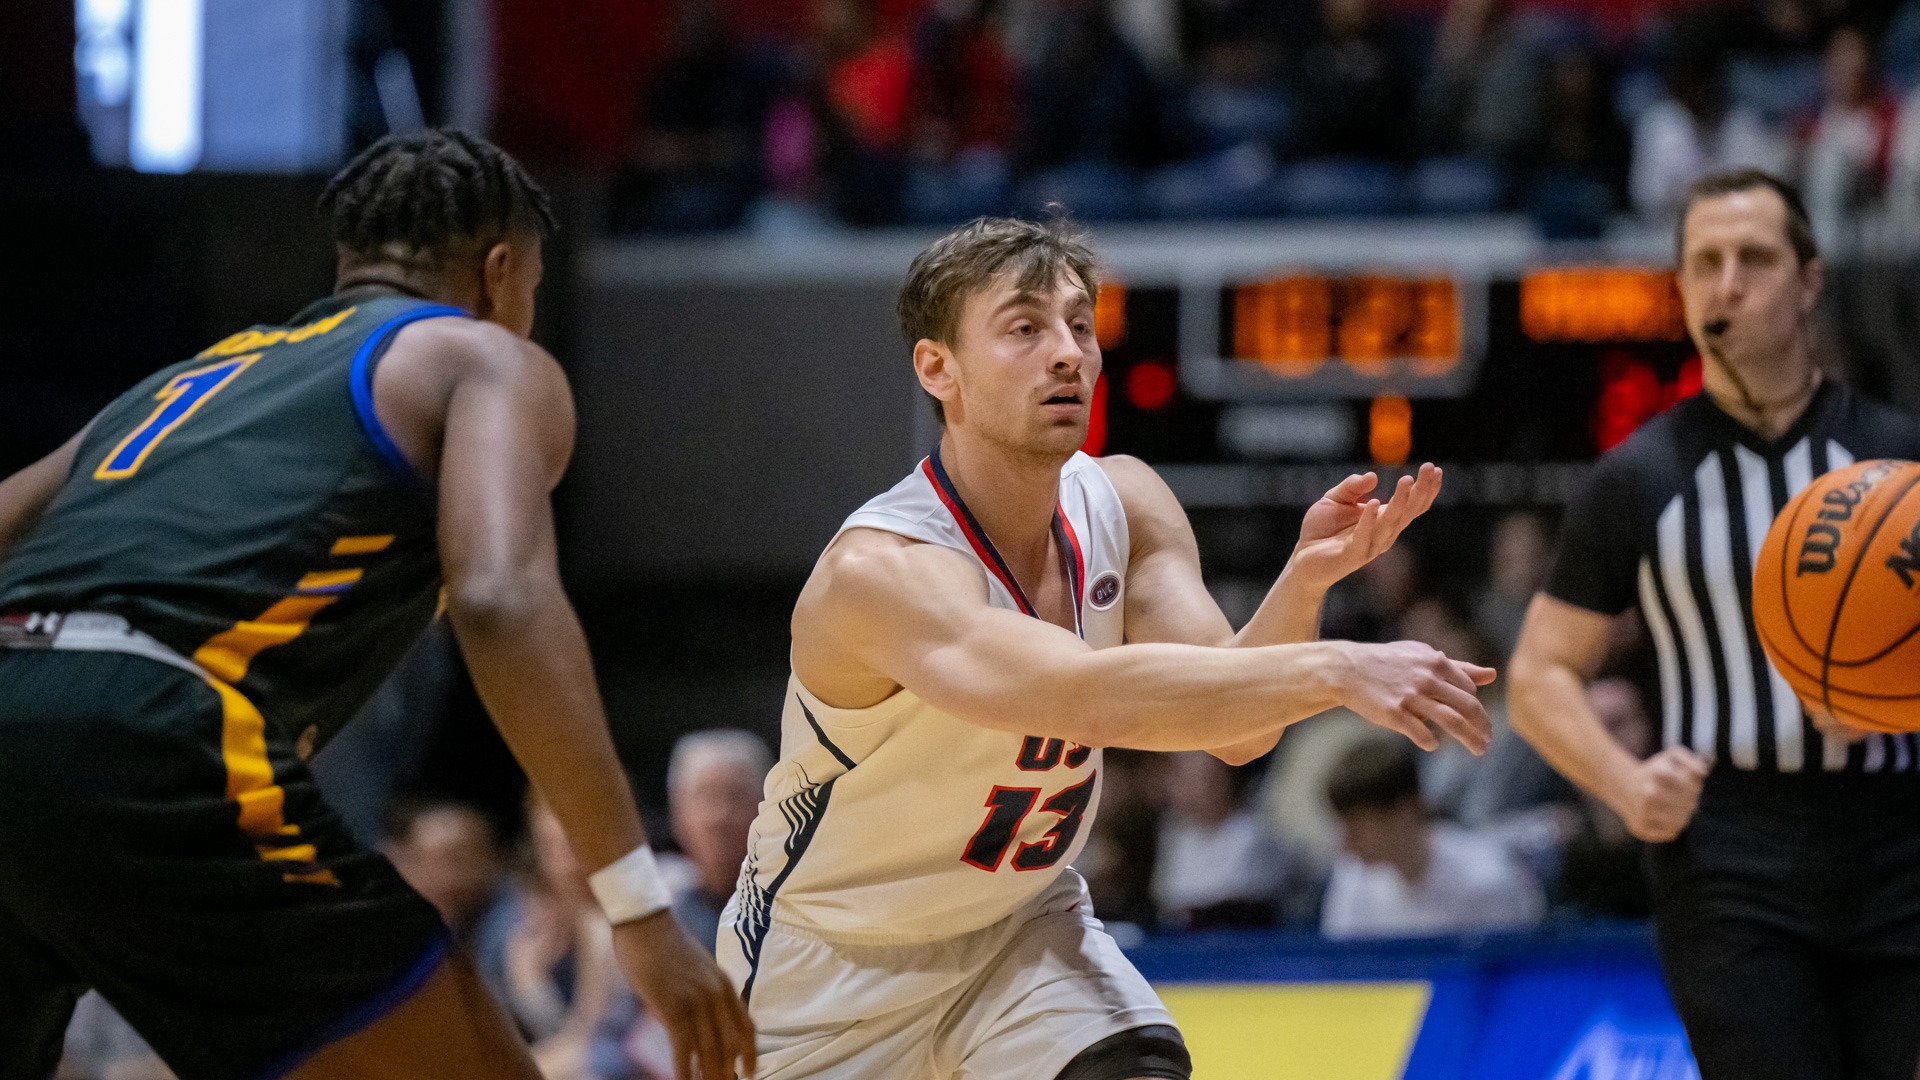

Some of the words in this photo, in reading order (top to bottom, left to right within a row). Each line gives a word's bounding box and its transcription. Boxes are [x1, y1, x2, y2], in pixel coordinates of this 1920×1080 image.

[93, 352, 264, 480] 1
[1096, 582, 1115, 600] OVC
[960, 769, 1097, 872] 13
